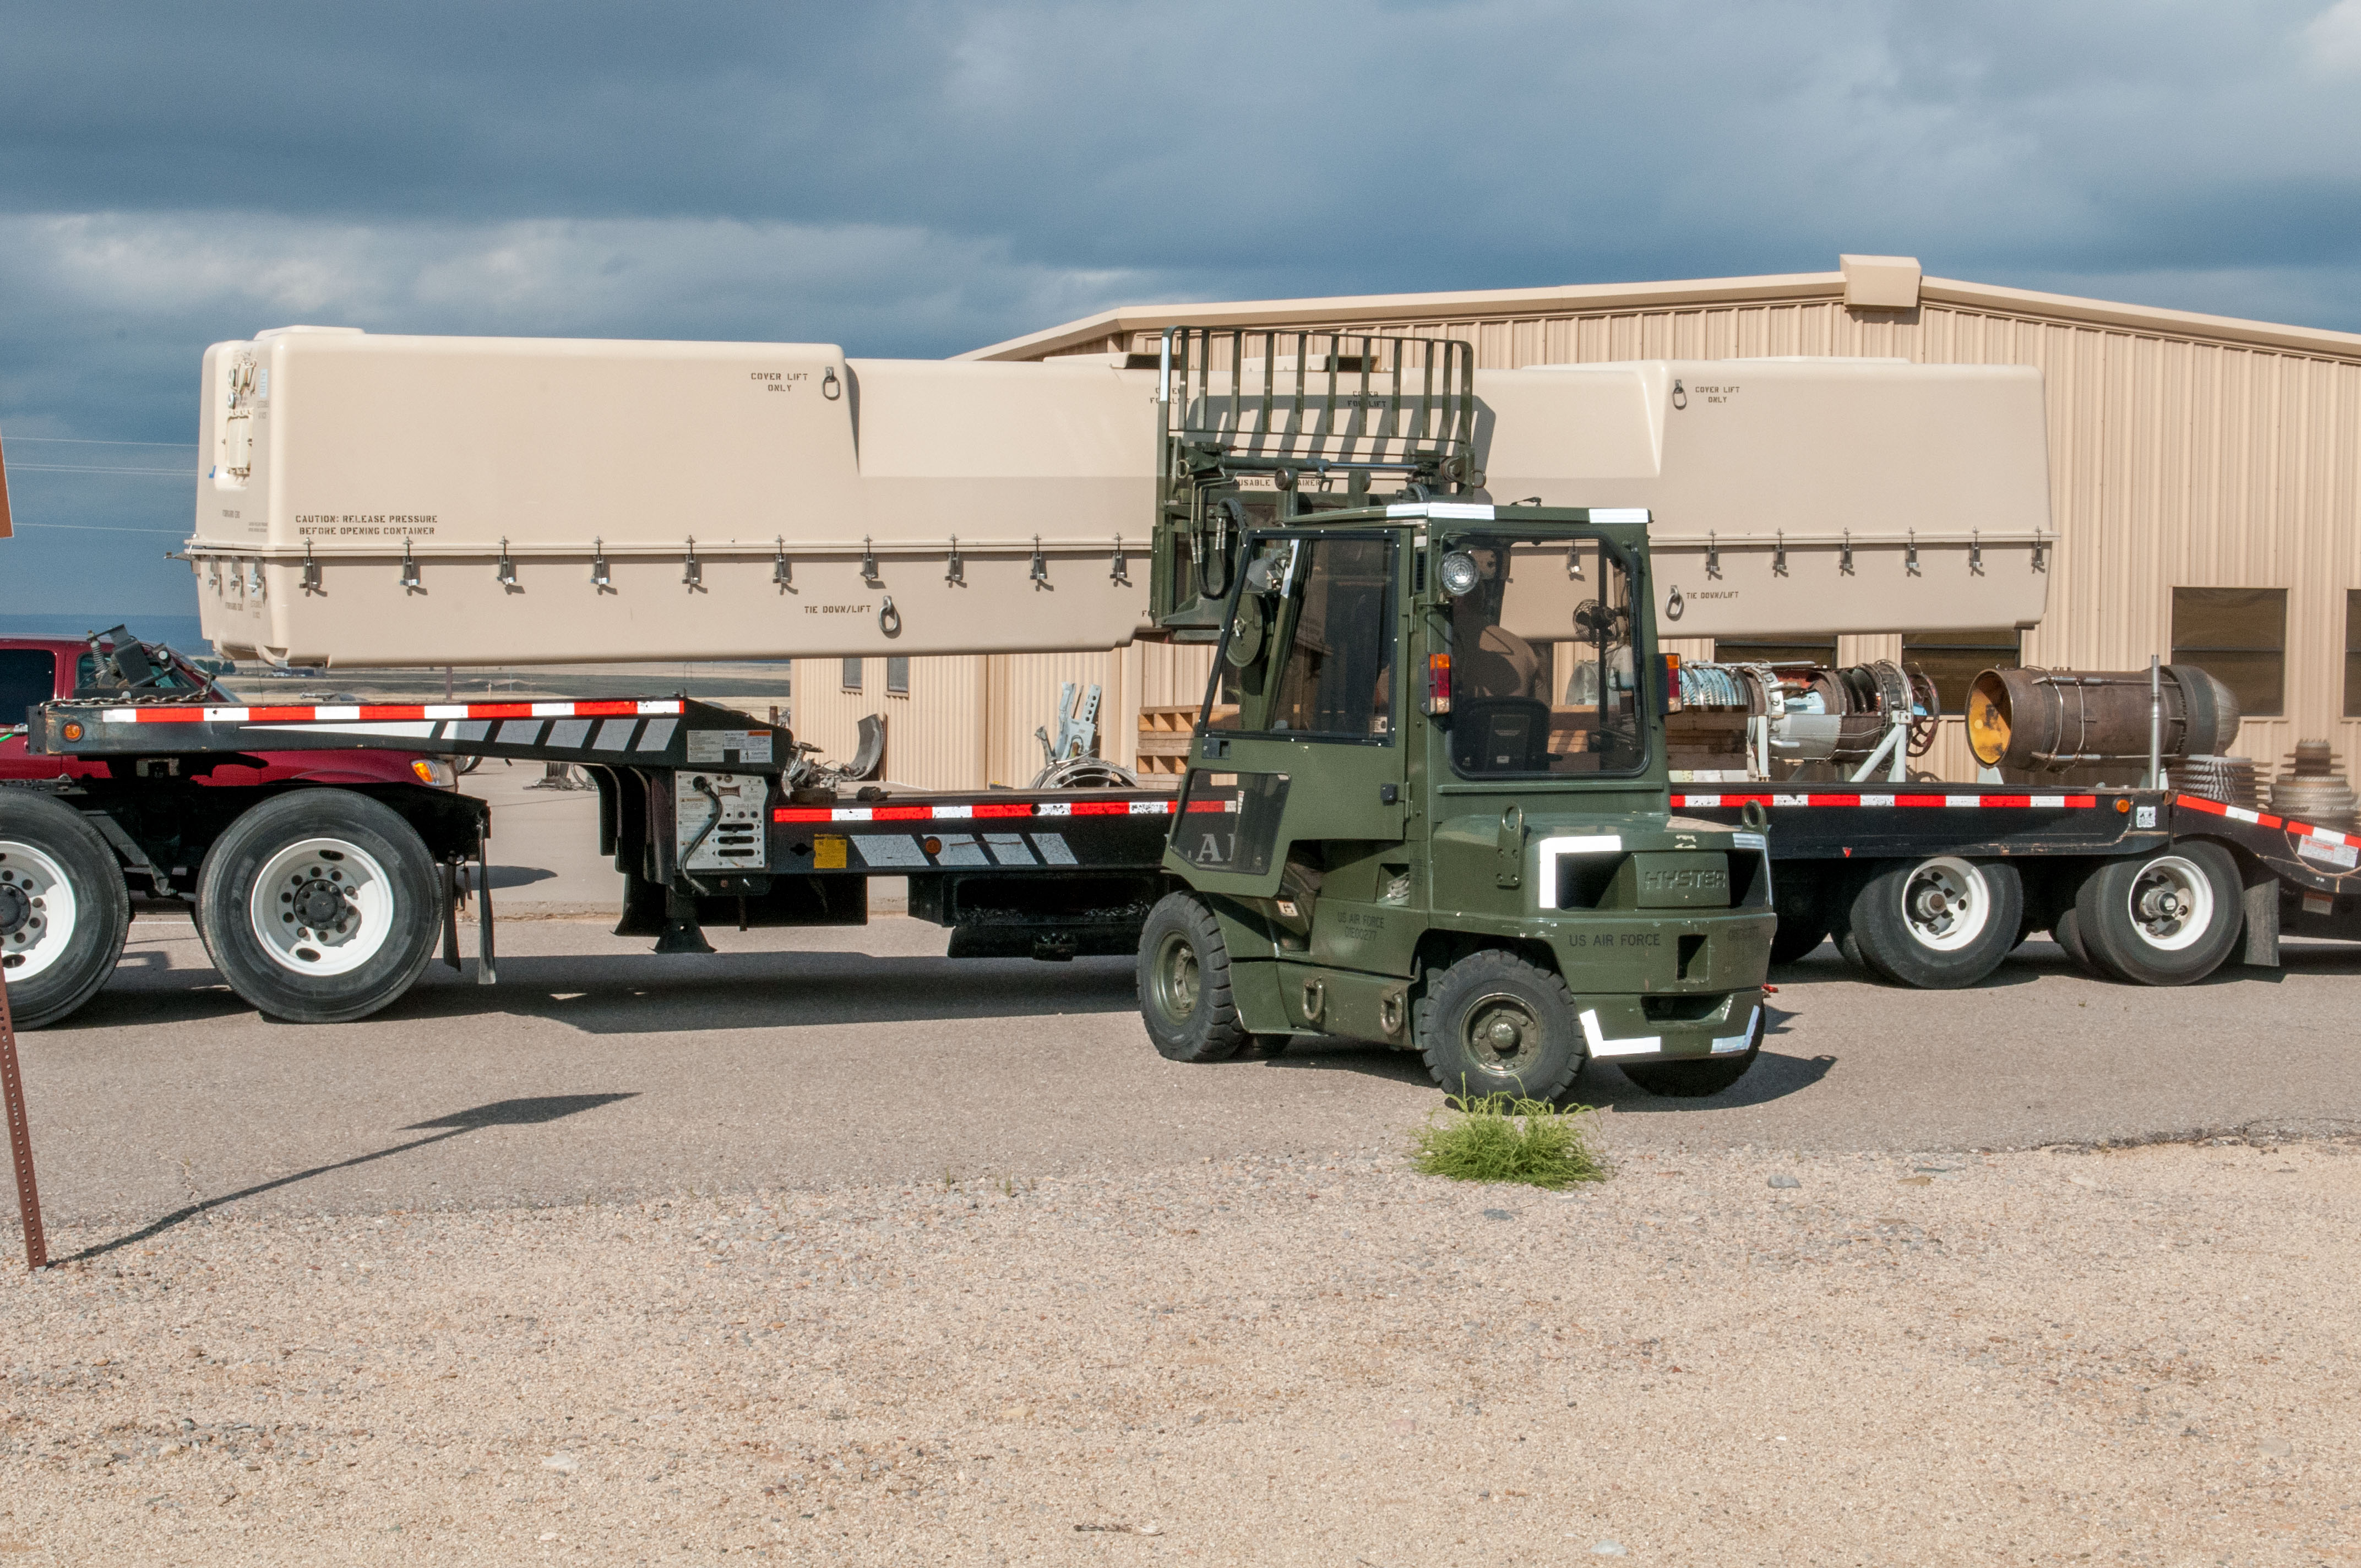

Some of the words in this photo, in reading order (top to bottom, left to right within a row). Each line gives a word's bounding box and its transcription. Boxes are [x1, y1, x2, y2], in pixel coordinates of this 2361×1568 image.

[750, 372, 781, 380] COVER
[787, 373, 808, 381] LIFT
[295, 515, 339, 523] CAUTION:
[342, 515, 386, 523] RELEASE
[389, 515, 438, 523] PRESSURE
[299, 527, 336, 535] BEFORE
[340, 527, 380, 535] OPENING
[383, 527, 435, 535] CONTAINER
[804, 606, 818, 614] TIE
[823, 605, 871, 613] DOWN/LIFT
[1644, 869, 1726, 890] HYSTER
[1337, 911, 1347, 923] US
[1348, 913, 1361, 924] AIR
[1363, 914, 1385, 929] FORCE
[1569, 934, 1587, 947] US
[1593, 934, 1614, 947] AIR
[1621, 933, 1661, 946] FORCE
